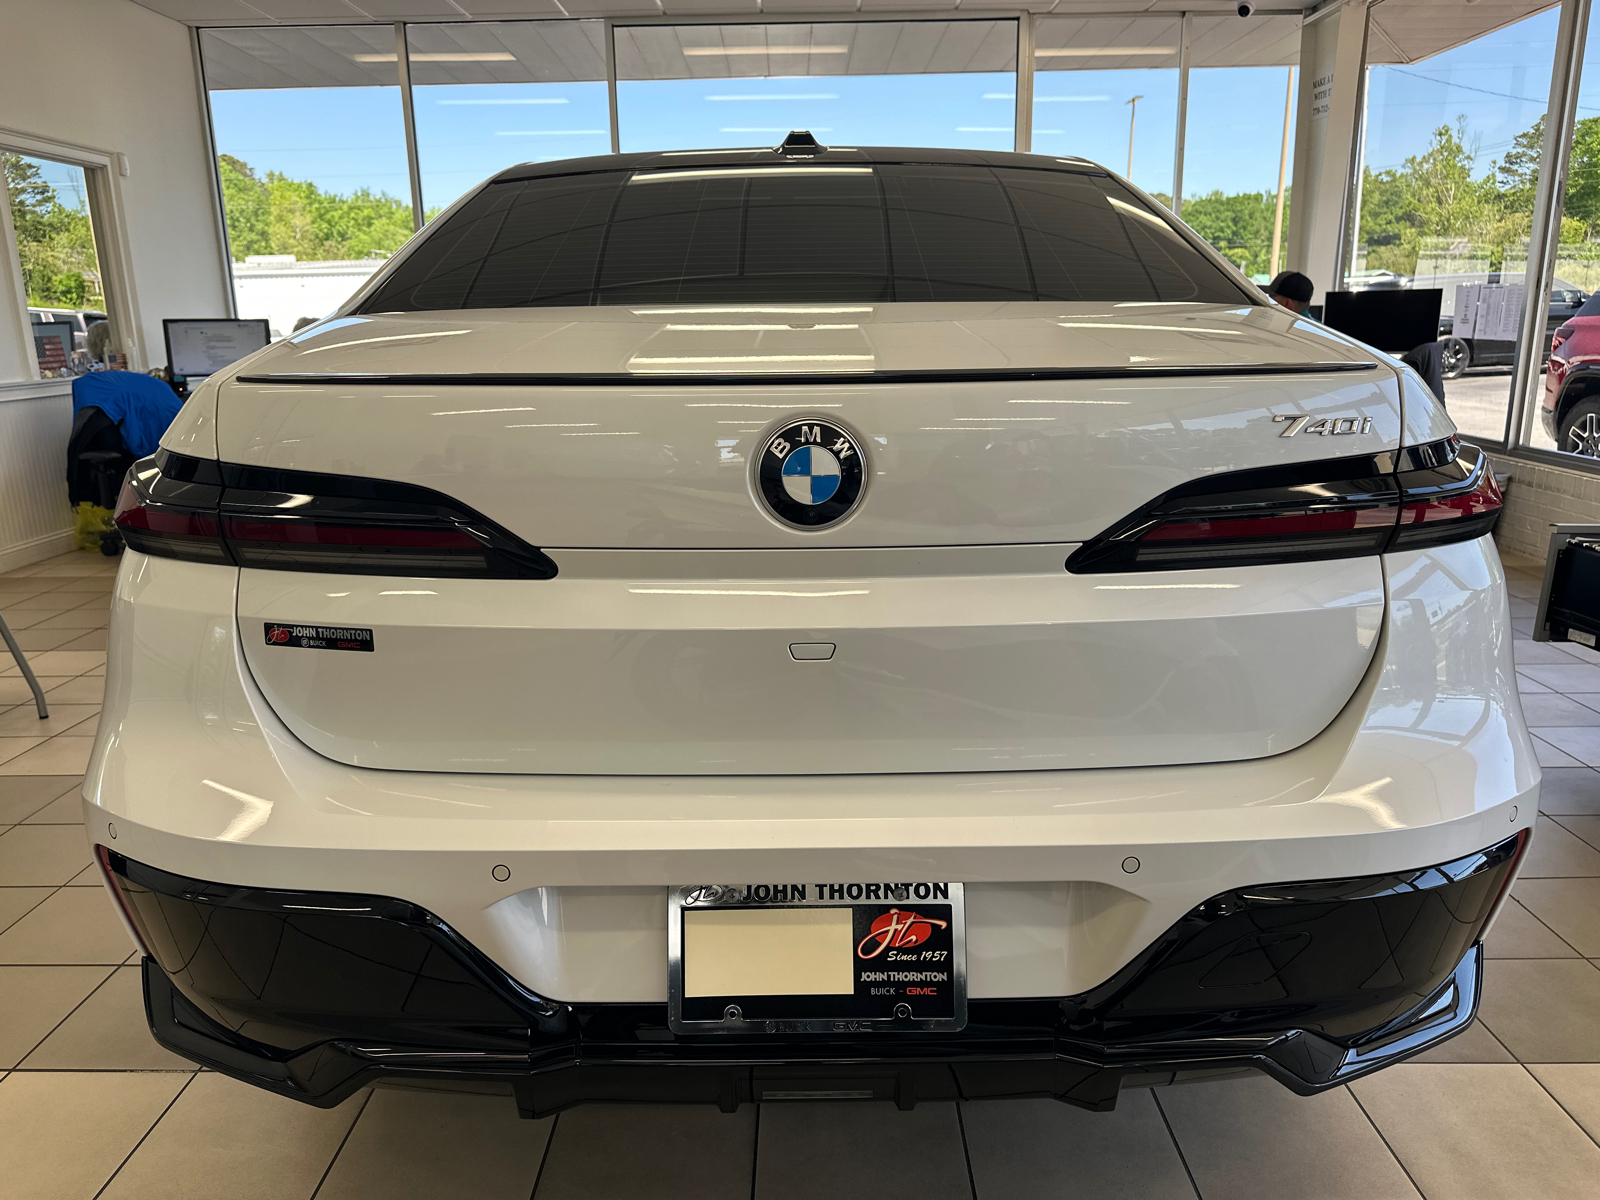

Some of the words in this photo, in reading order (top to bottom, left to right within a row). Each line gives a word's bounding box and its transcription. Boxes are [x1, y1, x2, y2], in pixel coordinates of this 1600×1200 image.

[1272, 414, 1373, 438] 740i
[769, 425, 854, 459] BMW
[292, 626, 317, 638] JOHN
[318, 628, 371, 641] THORNTON
[337, 641, 361, 649] GMC
[742, 884, 807, 901] JOHN
[815, 883, 949, 900] THORNTON
[886, 950, 918, 961] Since
[920, 950, 948, 962] 1957
[860, 971, 888, 982] JOHN
[888, 971, 948, 982] THORNTON
[870, 987, 896, 996] BUICK
[906, 987, 938, 996] GMC
[832, 1020, 874, 1032] GMC
